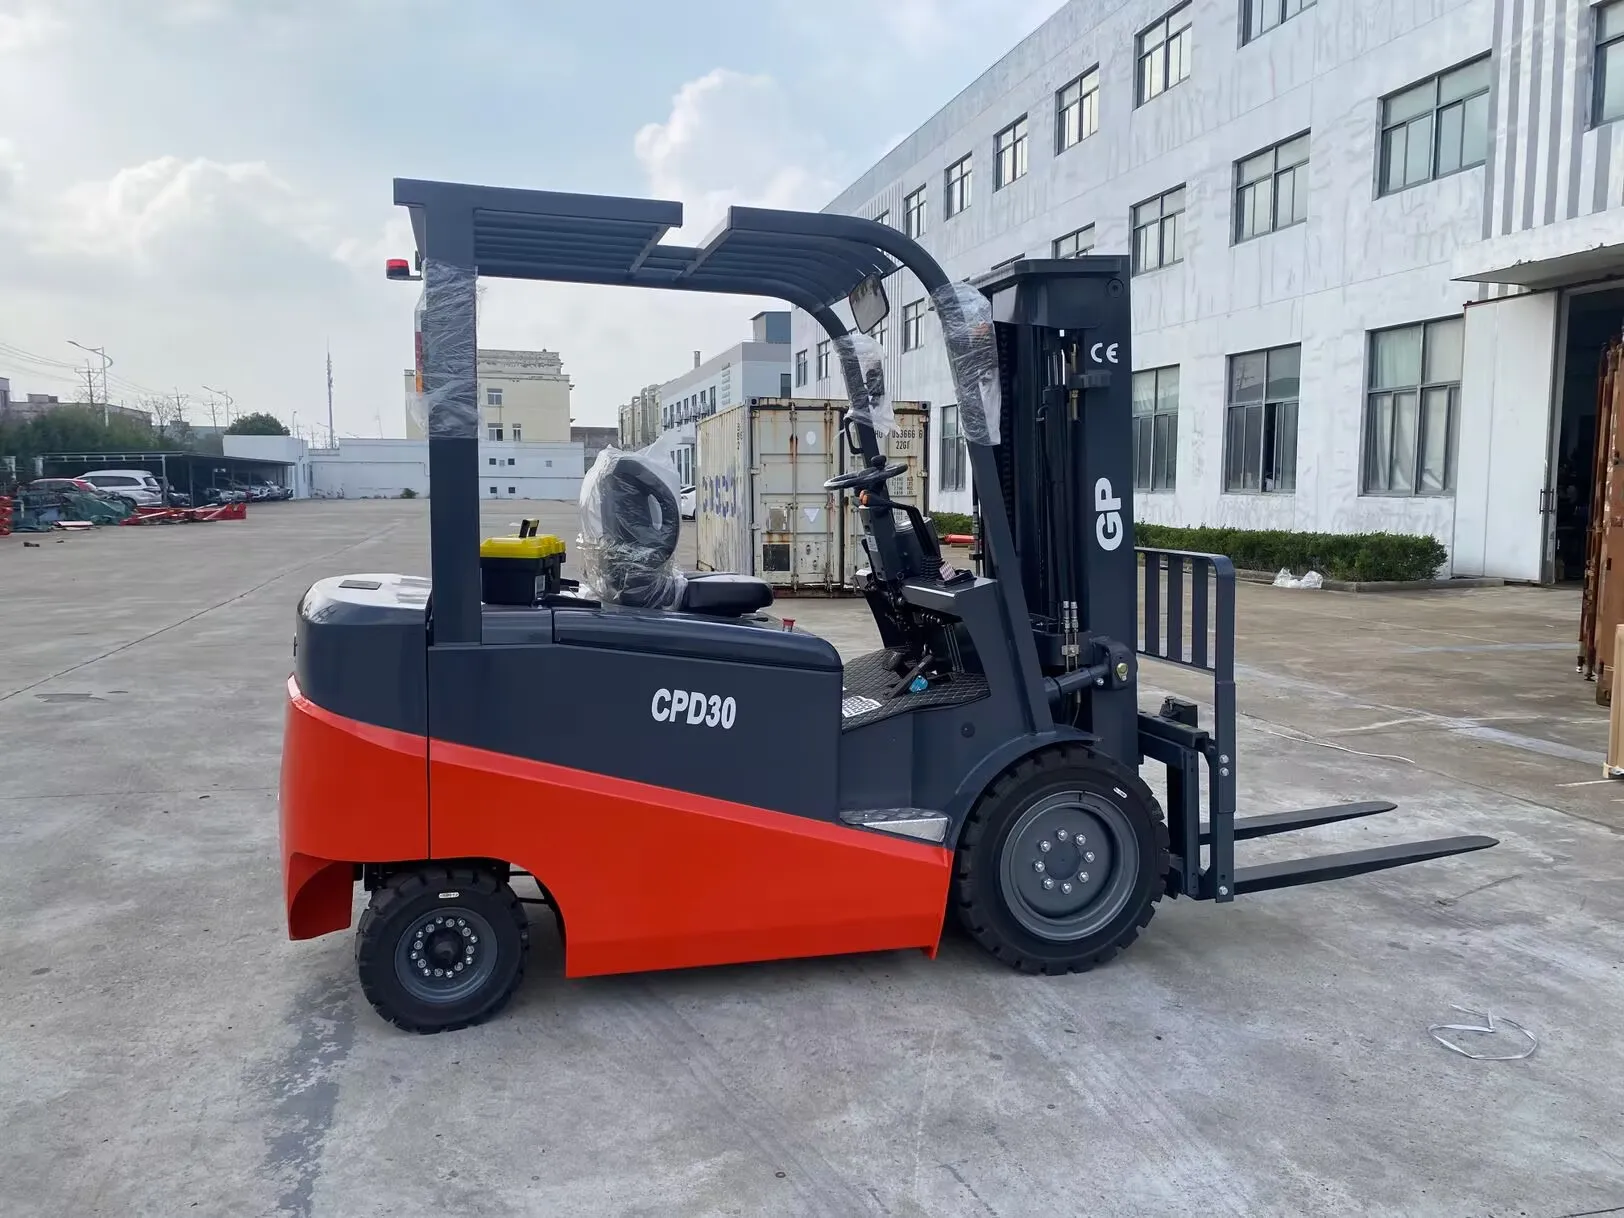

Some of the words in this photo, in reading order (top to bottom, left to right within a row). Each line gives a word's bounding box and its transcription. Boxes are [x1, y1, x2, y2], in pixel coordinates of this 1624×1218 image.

[1090, 342, 1119, 363] CE
[1094, 477, 1124, 551] GP
[651, 688, 737, 729] CPD30
